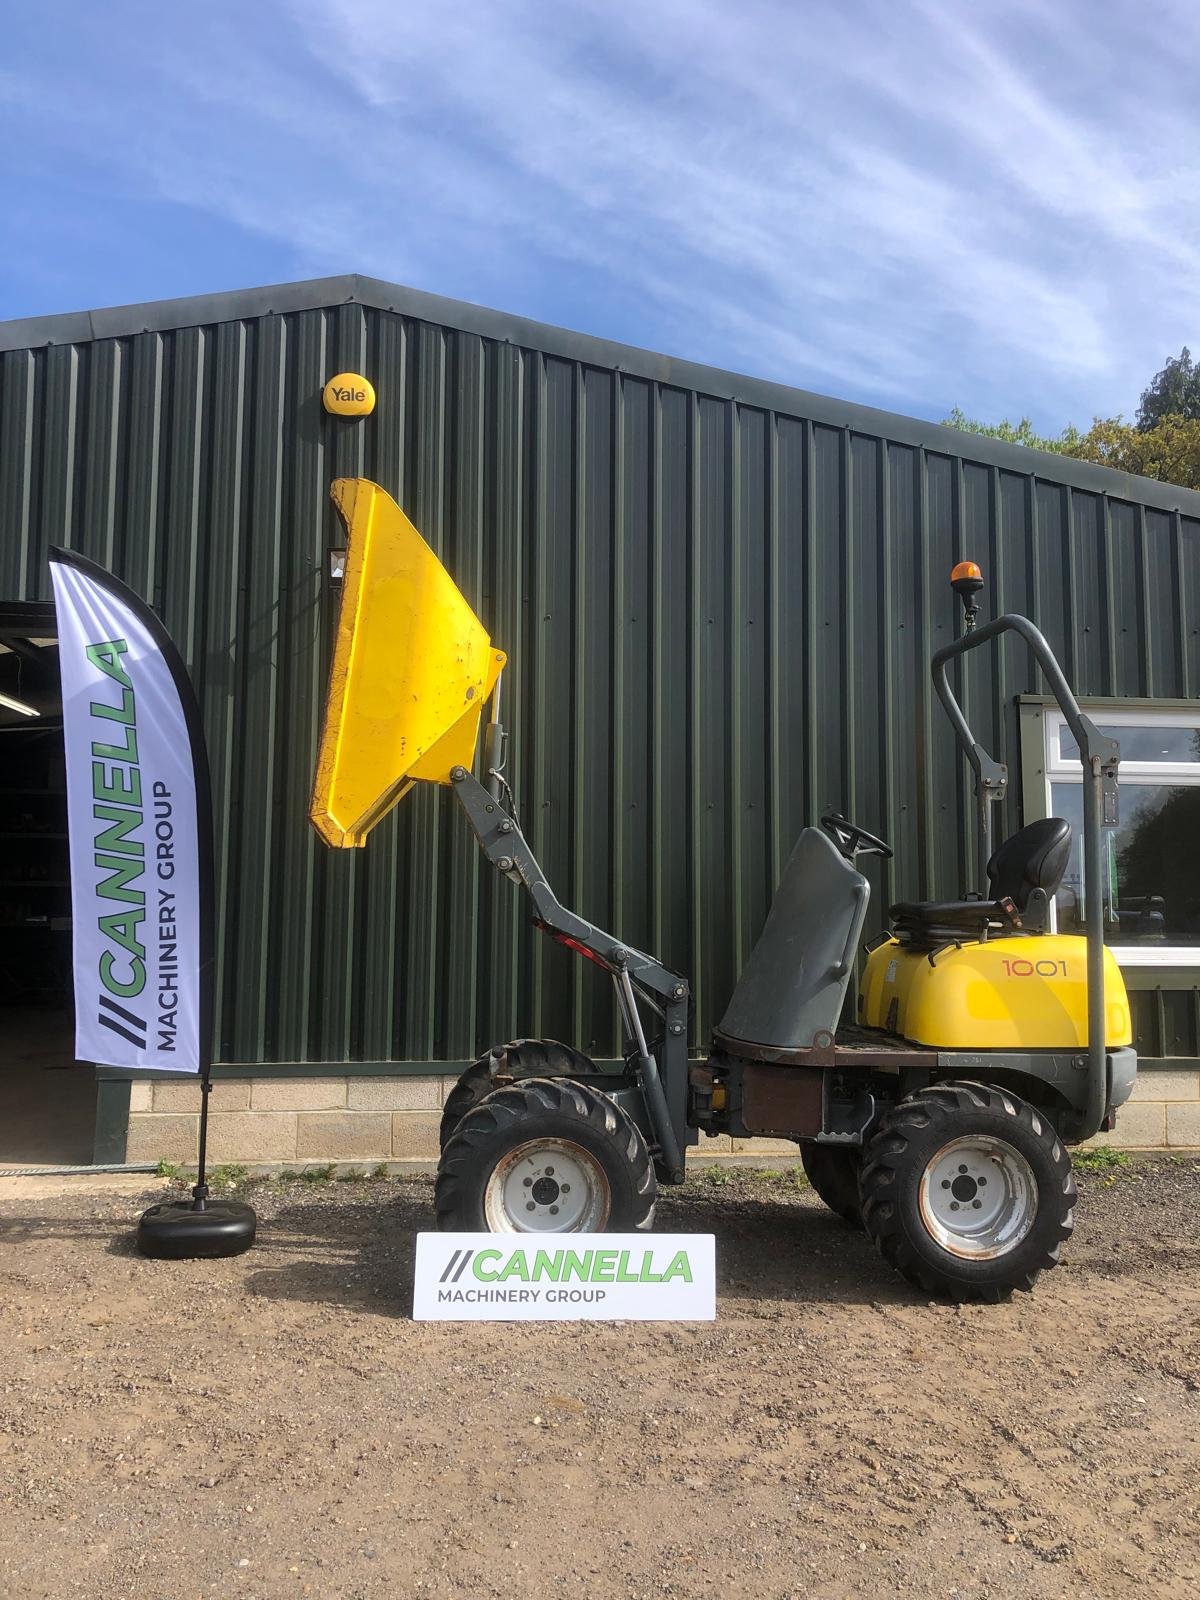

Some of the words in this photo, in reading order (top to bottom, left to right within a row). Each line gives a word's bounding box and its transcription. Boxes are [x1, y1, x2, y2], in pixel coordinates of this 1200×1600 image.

[331, 387, 366, 402] Yale
[152, 780, 176, 881] GROUP
[156, 888, 179, 1052] MACHINERY
[1002, 959, 1067, 977] 1001
[437, 1289, 541, 1303] MACHINERY
[545, 1289, 606, 1303] GROUP
